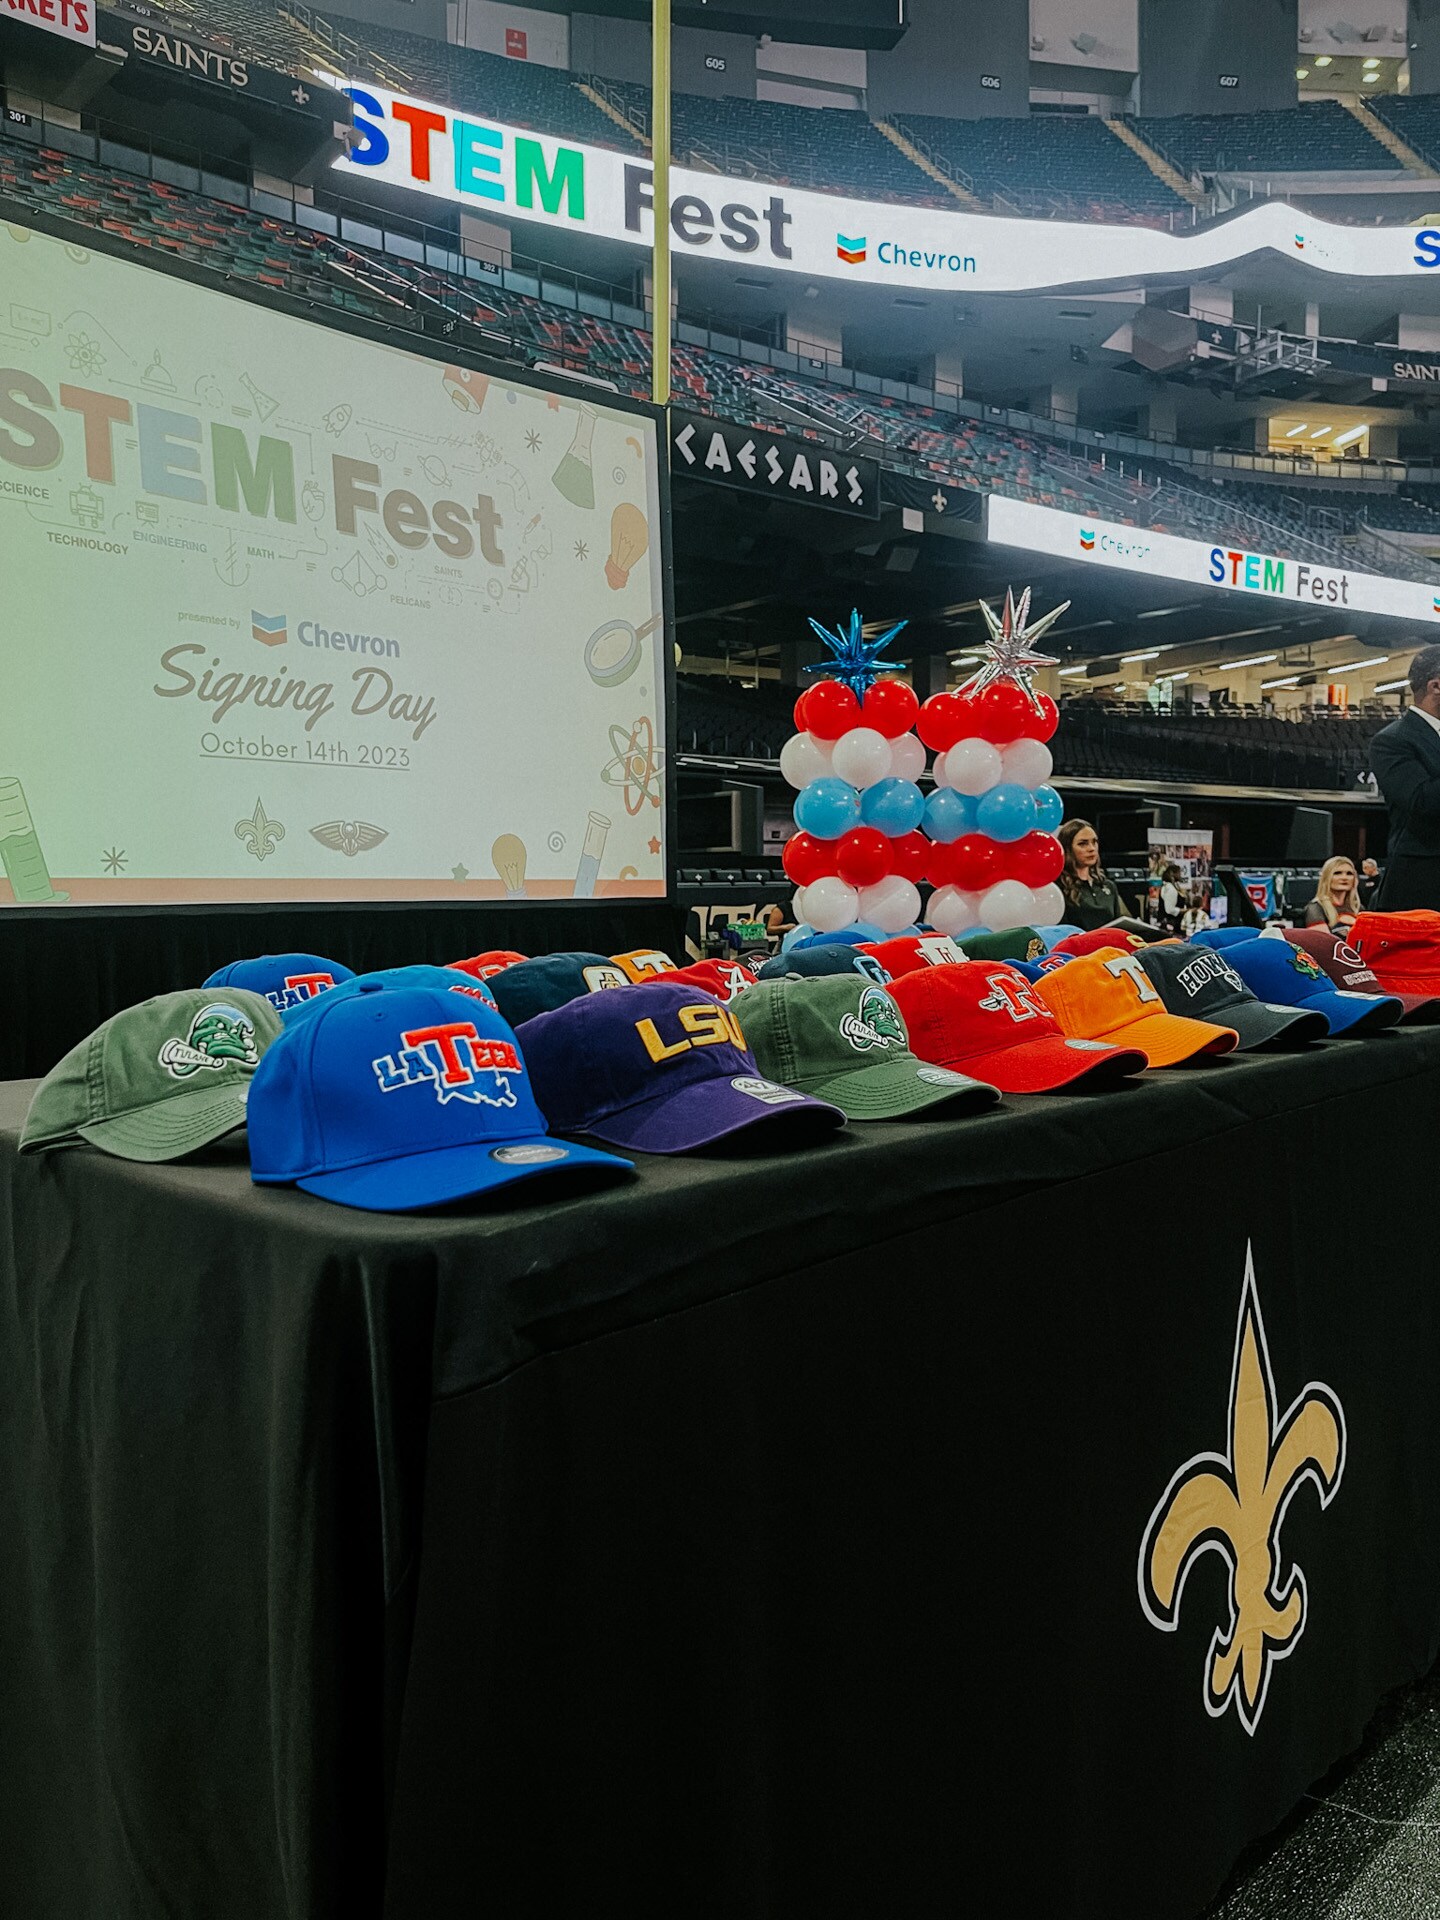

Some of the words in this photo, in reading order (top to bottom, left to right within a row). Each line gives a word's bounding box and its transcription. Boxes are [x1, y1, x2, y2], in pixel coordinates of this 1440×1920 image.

[132, 26, 249, 87] SAINTS
[705, 57, 726, 71] 605
[981, 76, 1001, 89] 606
[1219, 76, 1239, 87] 607
[9, 110, 26, 124] 301
[342, 87, 585, 221] STEM
[624, 163, 793, 260] Fest
[877, 241, 977, 273] Chevron
[0, 367, 298, 525] STEM
[332, 453, 505, 567] Fest
[46, 531, 129, 555] TECHNOLOGY
[132, 530, 208, 553] ENGINEERING
[246, 546, 276, 560] MATH
[433, 564, 463, 579] SAINTS
[1209, 548, 1285, 594] STEM
[1296, 566, 1349, 605] Fest
[389, 594, 432, 610] PELICANS
[177, 610, 227, 627] presented
[228, 616, 241, 630] by
[297, 621, 400, 659] Chevron
[153, 643, 335, 732] Signing
[350, 666, 438, 741] Day
[200, 732, 298, 760] October
[306, 740, 349, 763] 14th
[356, 744, 411, 767] 2023
